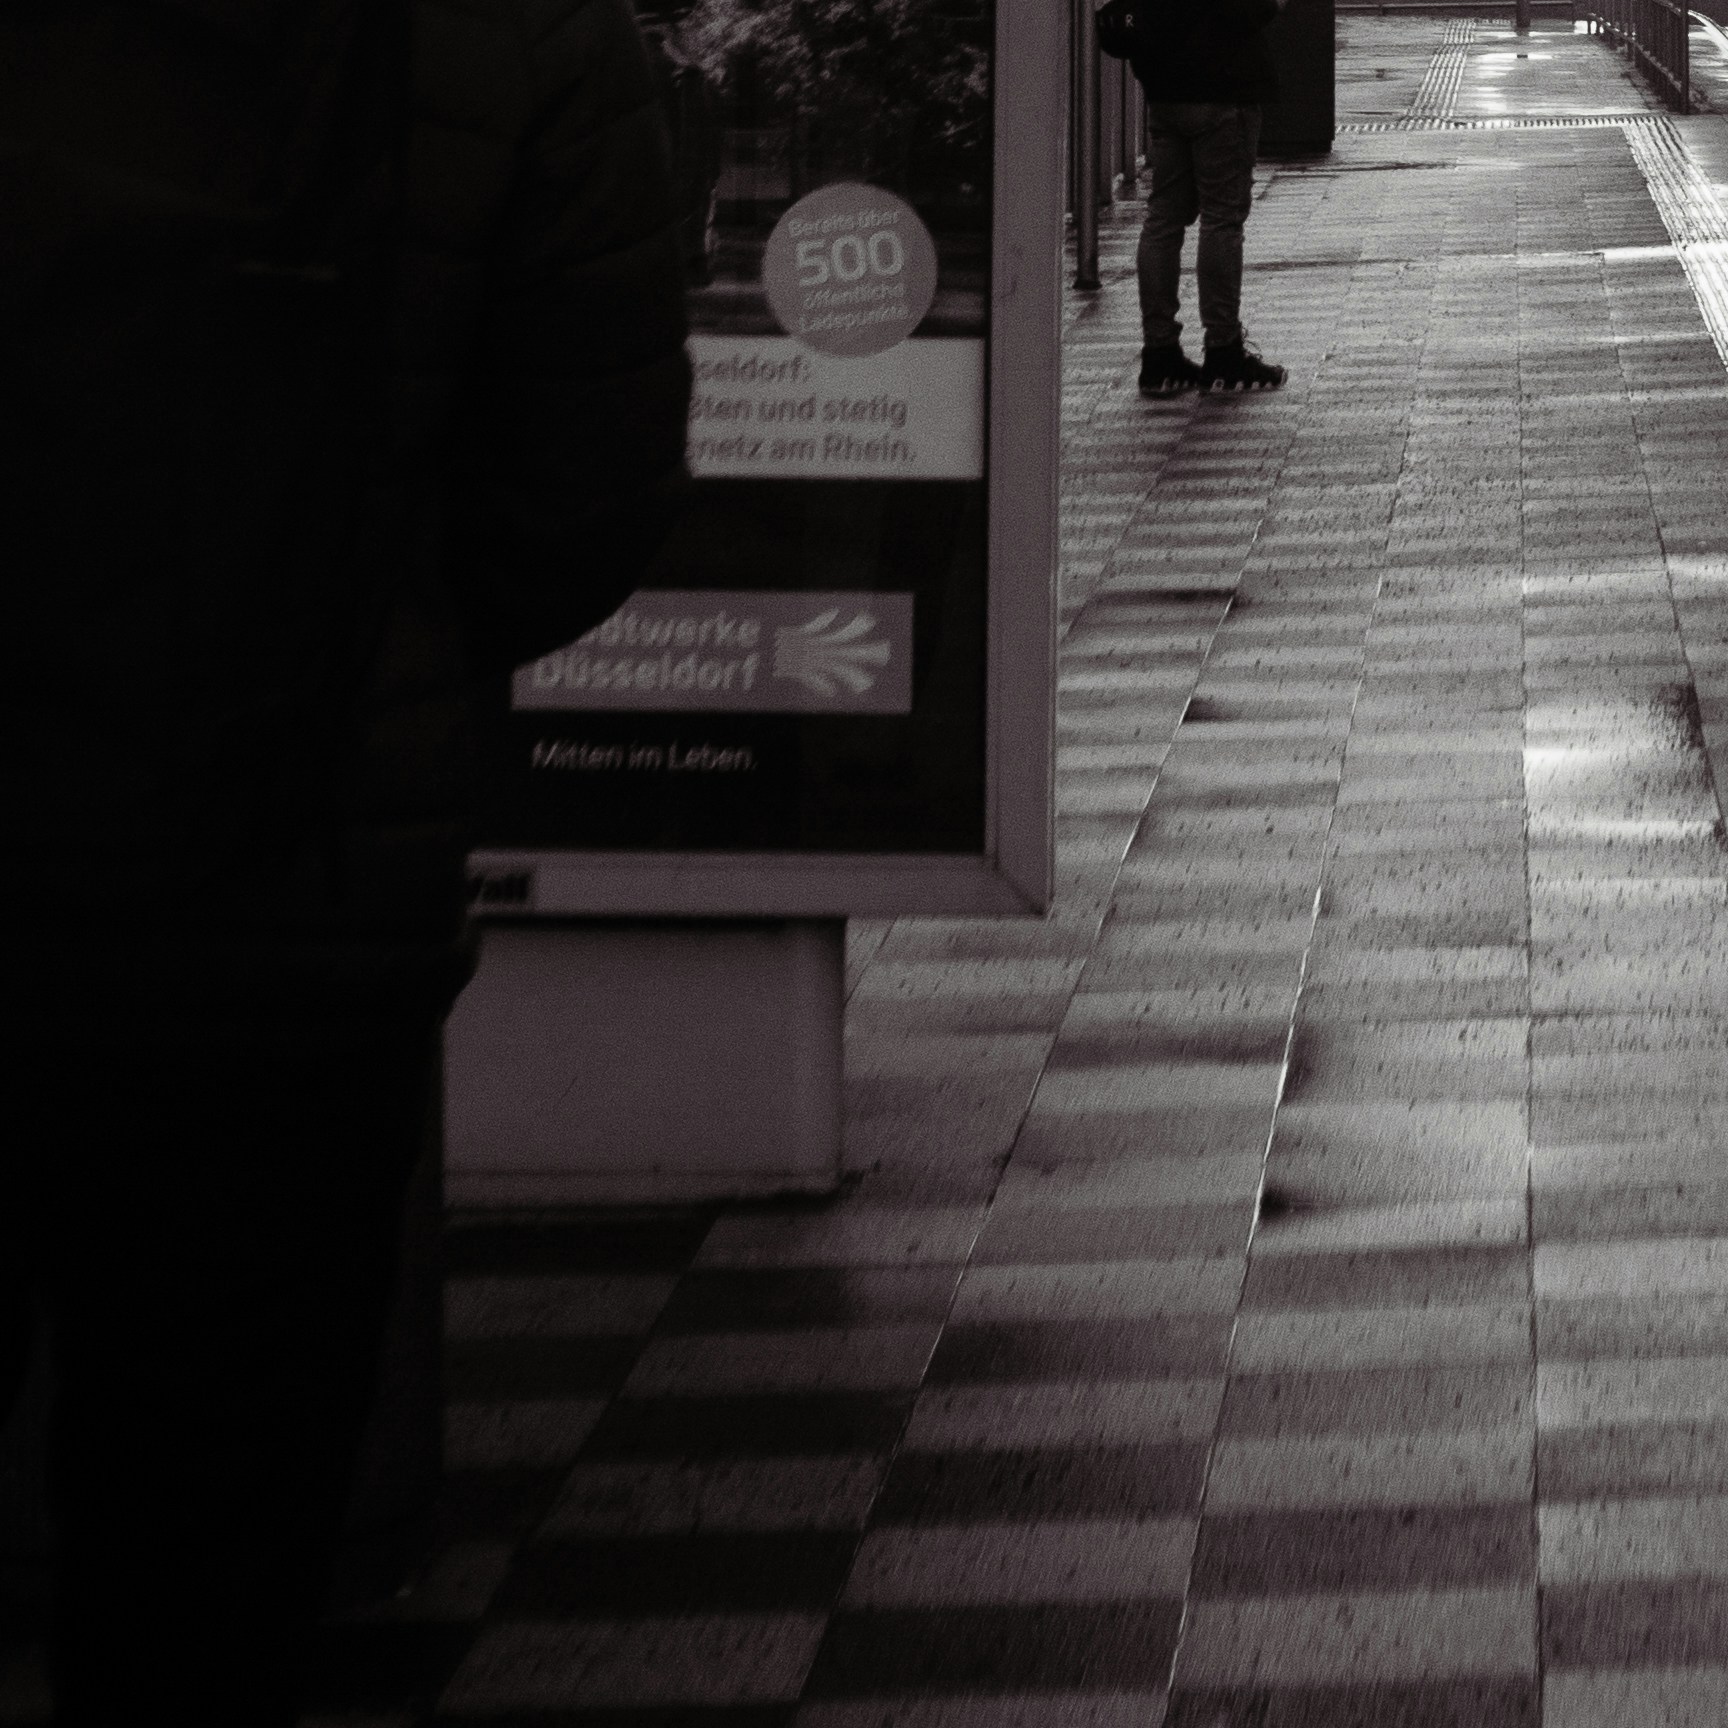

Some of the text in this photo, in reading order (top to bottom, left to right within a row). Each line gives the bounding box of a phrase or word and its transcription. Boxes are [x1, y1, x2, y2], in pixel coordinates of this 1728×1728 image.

[796, 229, 905, 287] 500
[757, 392, 817, 422] und
[822, 393, 907, 429] stetig
[769, 438, 816, 462] am
[531, 649, 762, 691] Düsseldorf
[530, 738, 624, 770] Mitten
[627, 739, 662, 770] im
